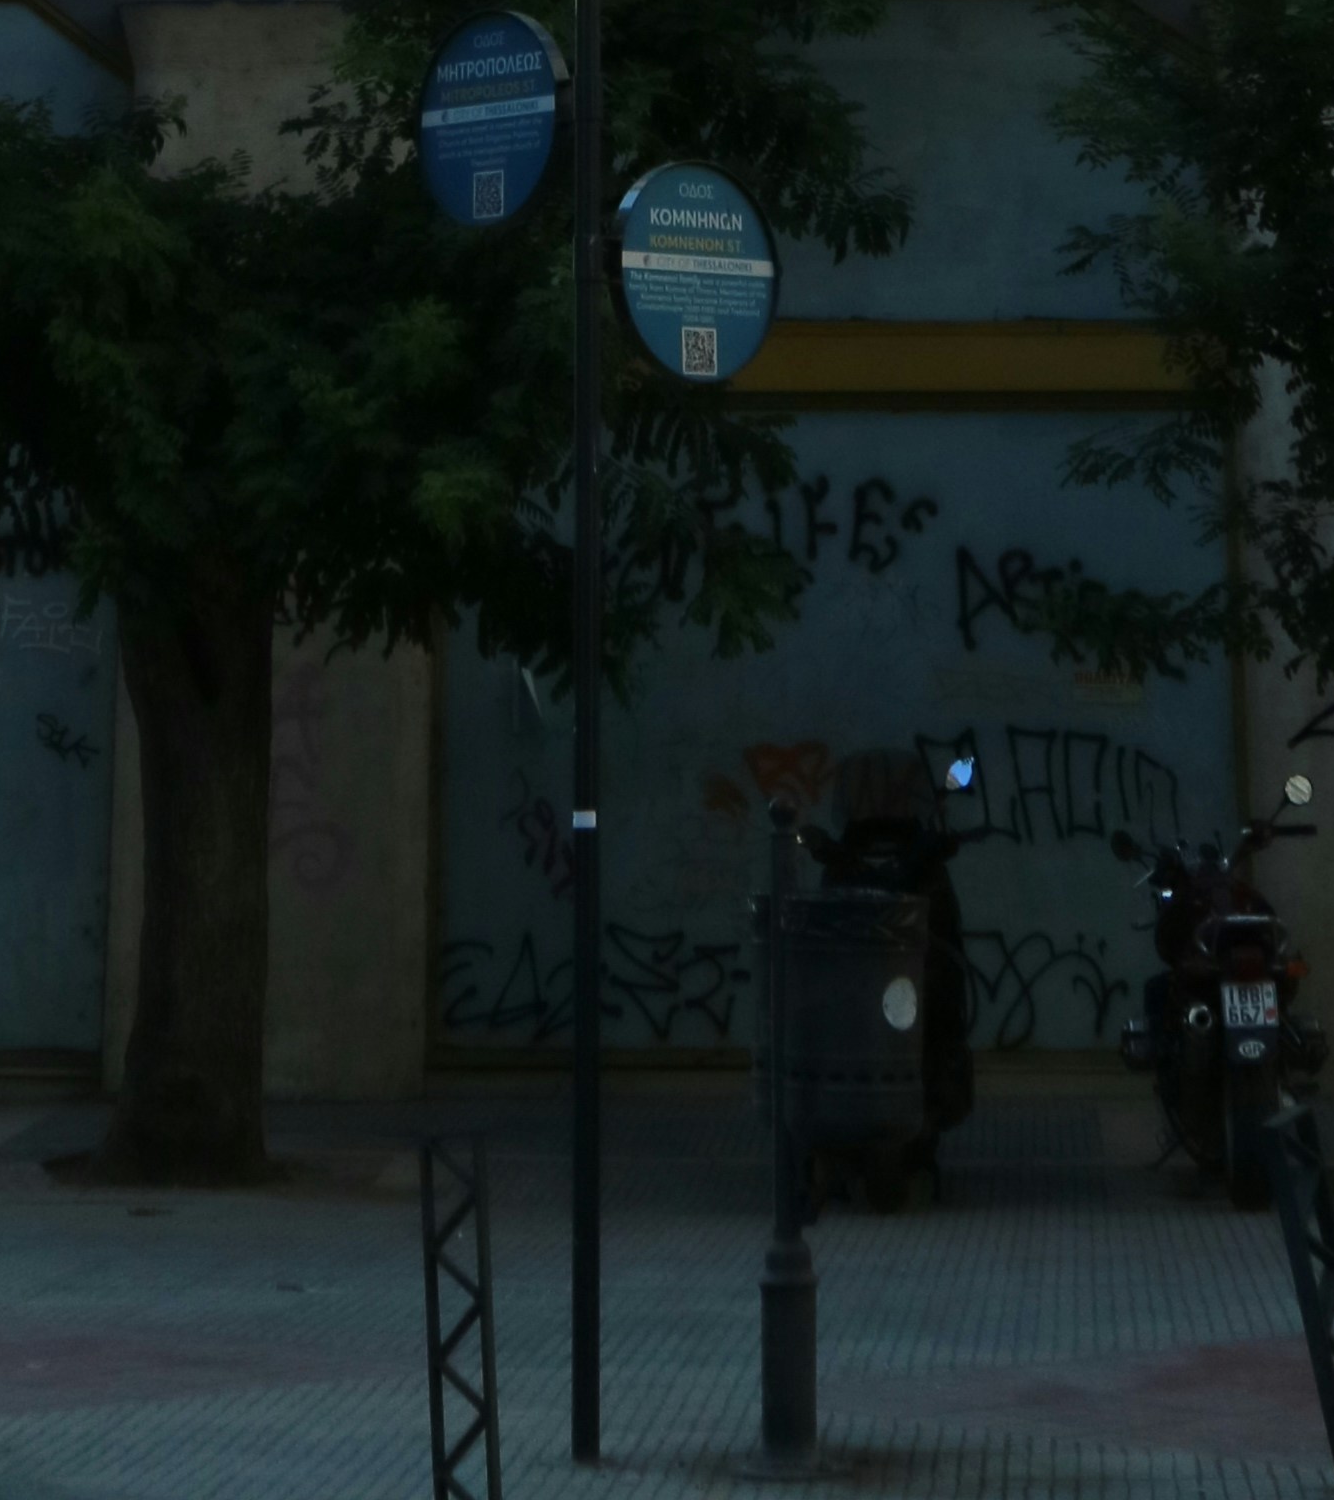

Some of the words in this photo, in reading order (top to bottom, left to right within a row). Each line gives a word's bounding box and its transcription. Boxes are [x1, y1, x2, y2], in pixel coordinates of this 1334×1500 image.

[473, 31, 505, 48] ΟΔΟΣ
[437, 51, 542, 83] ΜΗΤΡΟΠΟΛΕΩΣ
[679, 182, 714, 199] ΟΔΟΣ
[650, 207, 743, 231] ΚΟΜΝΗΝΩΝ
[650, 233, 724, 251] KOMNENON
